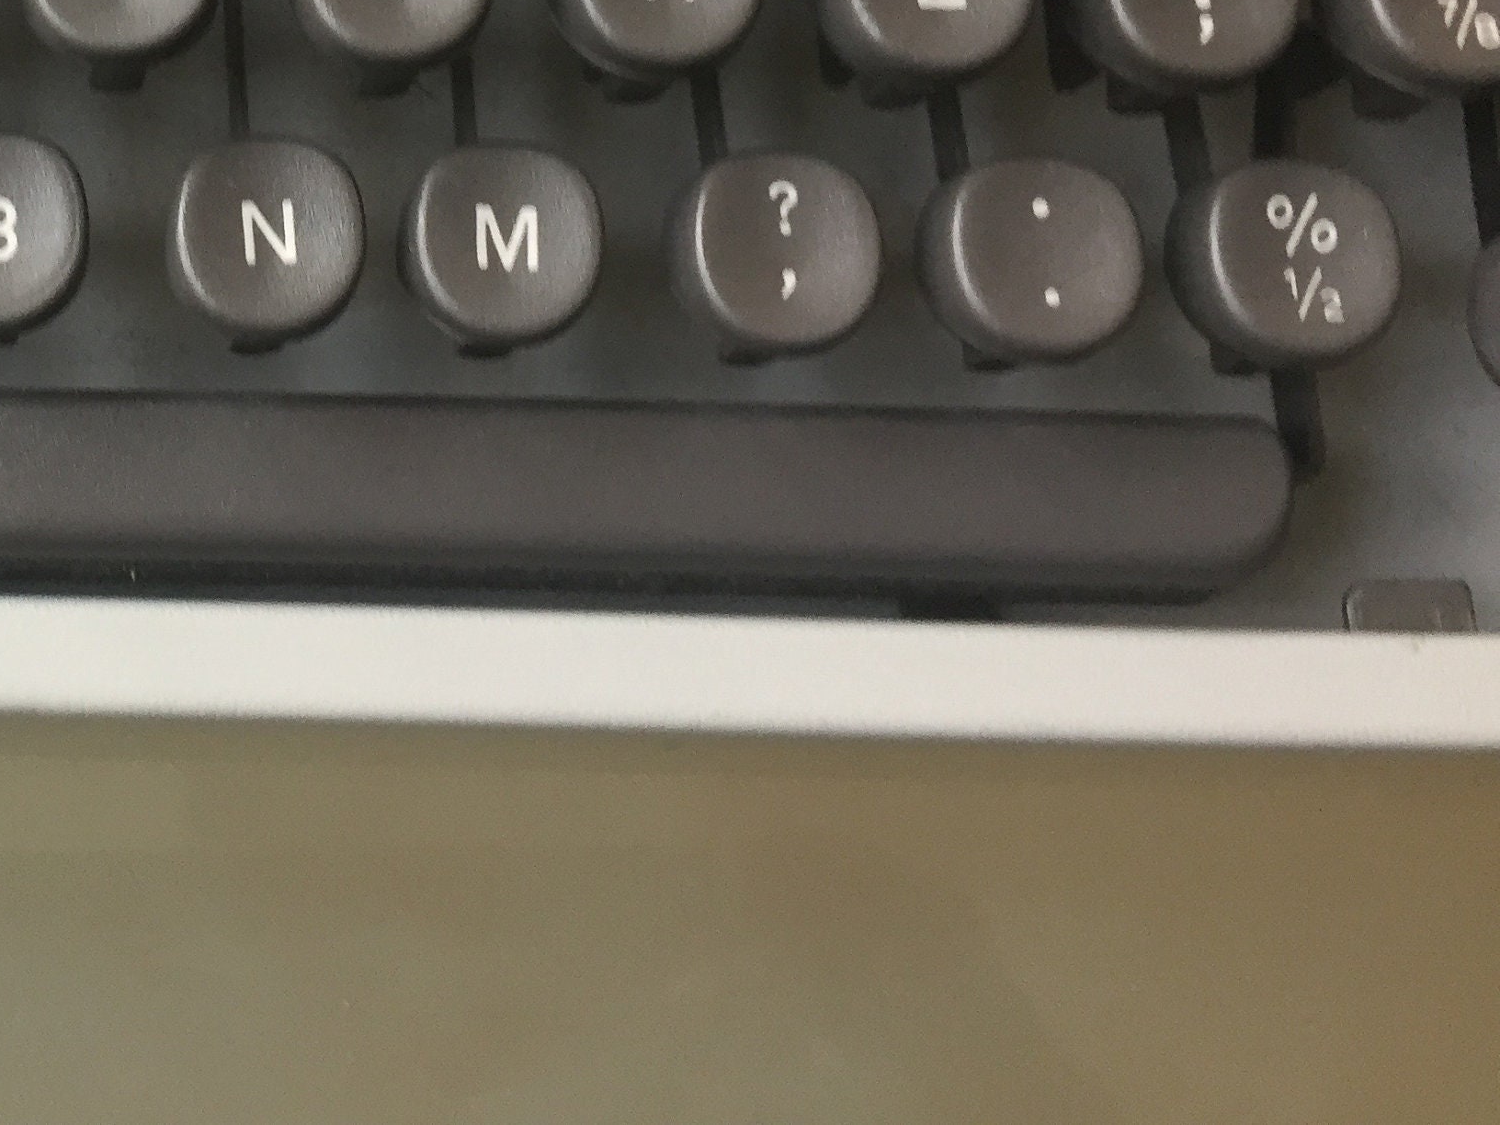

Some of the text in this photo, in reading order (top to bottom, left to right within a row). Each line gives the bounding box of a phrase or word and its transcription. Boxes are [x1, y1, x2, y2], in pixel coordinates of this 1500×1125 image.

[241, 198, 298, 268] N
[474, 201, 540, 274] M
[769, 180, 799, 237] ?
[1266, 192, 1339, 258] %
